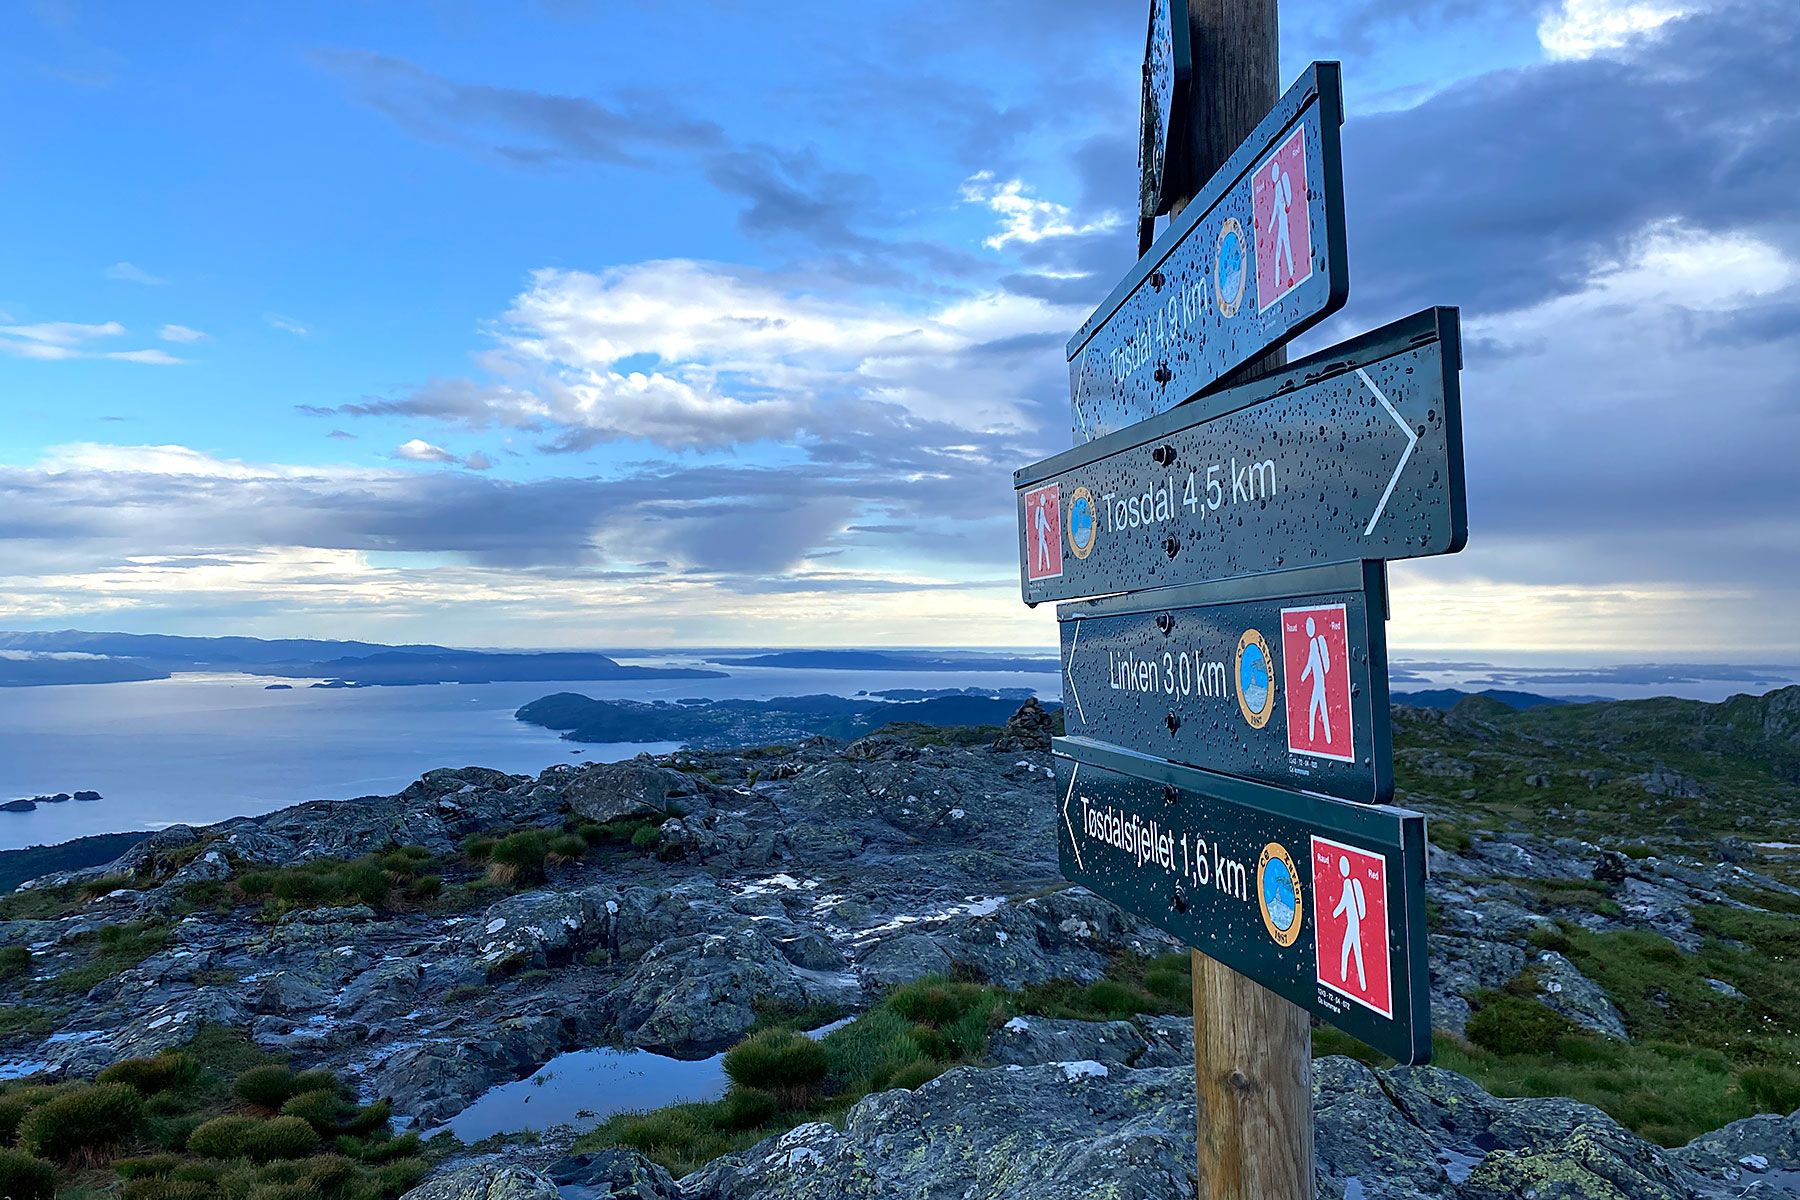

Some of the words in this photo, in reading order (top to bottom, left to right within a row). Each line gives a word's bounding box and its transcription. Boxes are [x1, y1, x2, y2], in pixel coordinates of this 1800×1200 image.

[1156, 296, 1178, 350] 4,9
[1182, 277, 1208, 328] km
[1102, 476, 1175, 533] Tøsdal
[1183, 464, 1223, 520] 4,5
[1231, 457, 1277, 504] km
[1109, 651, 1159, 692] Linken
[1163, 651, 1191, 702] 3,0
[1196, 650, 1227, 698] km
[1080, 796, 1176, 868] Tøsdalsfjellet
[1180, 832, 1209, 888] 1,6
[1213, 842, 1248, 902] km
[1367, 868, 1379, 881] Red
